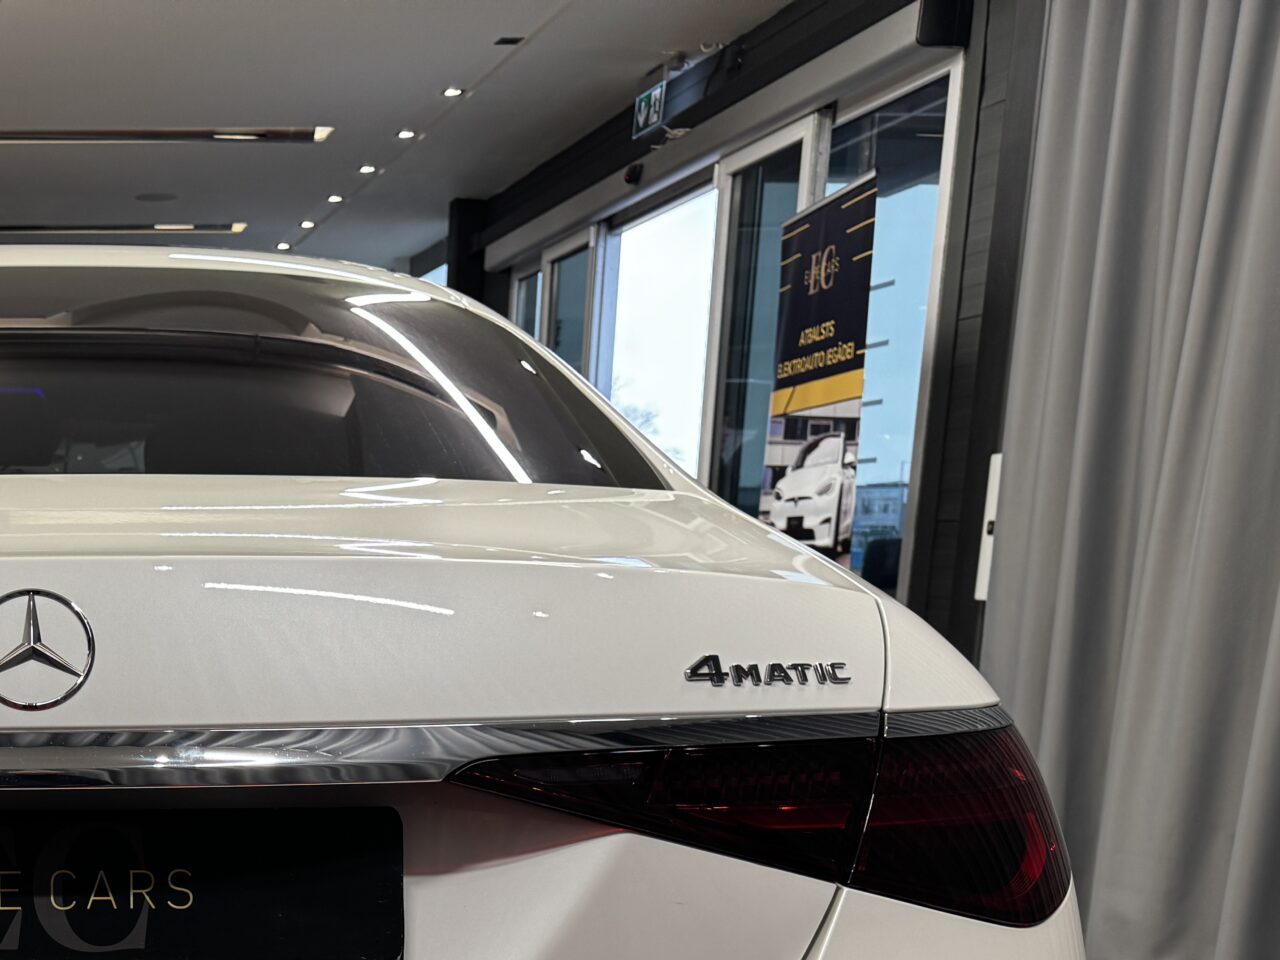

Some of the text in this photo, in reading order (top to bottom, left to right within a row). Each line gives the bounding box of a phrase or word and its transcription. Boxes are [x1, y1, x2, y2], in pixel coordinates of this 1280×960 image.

[797, 319, 836, 348] ATBALSTS
[776, 342, 855, 379] ELEKTROAUTO IEGĀDEI
[683, 654, 852, 687] 4MATIC
[50, 869, 194, 911] CARS
